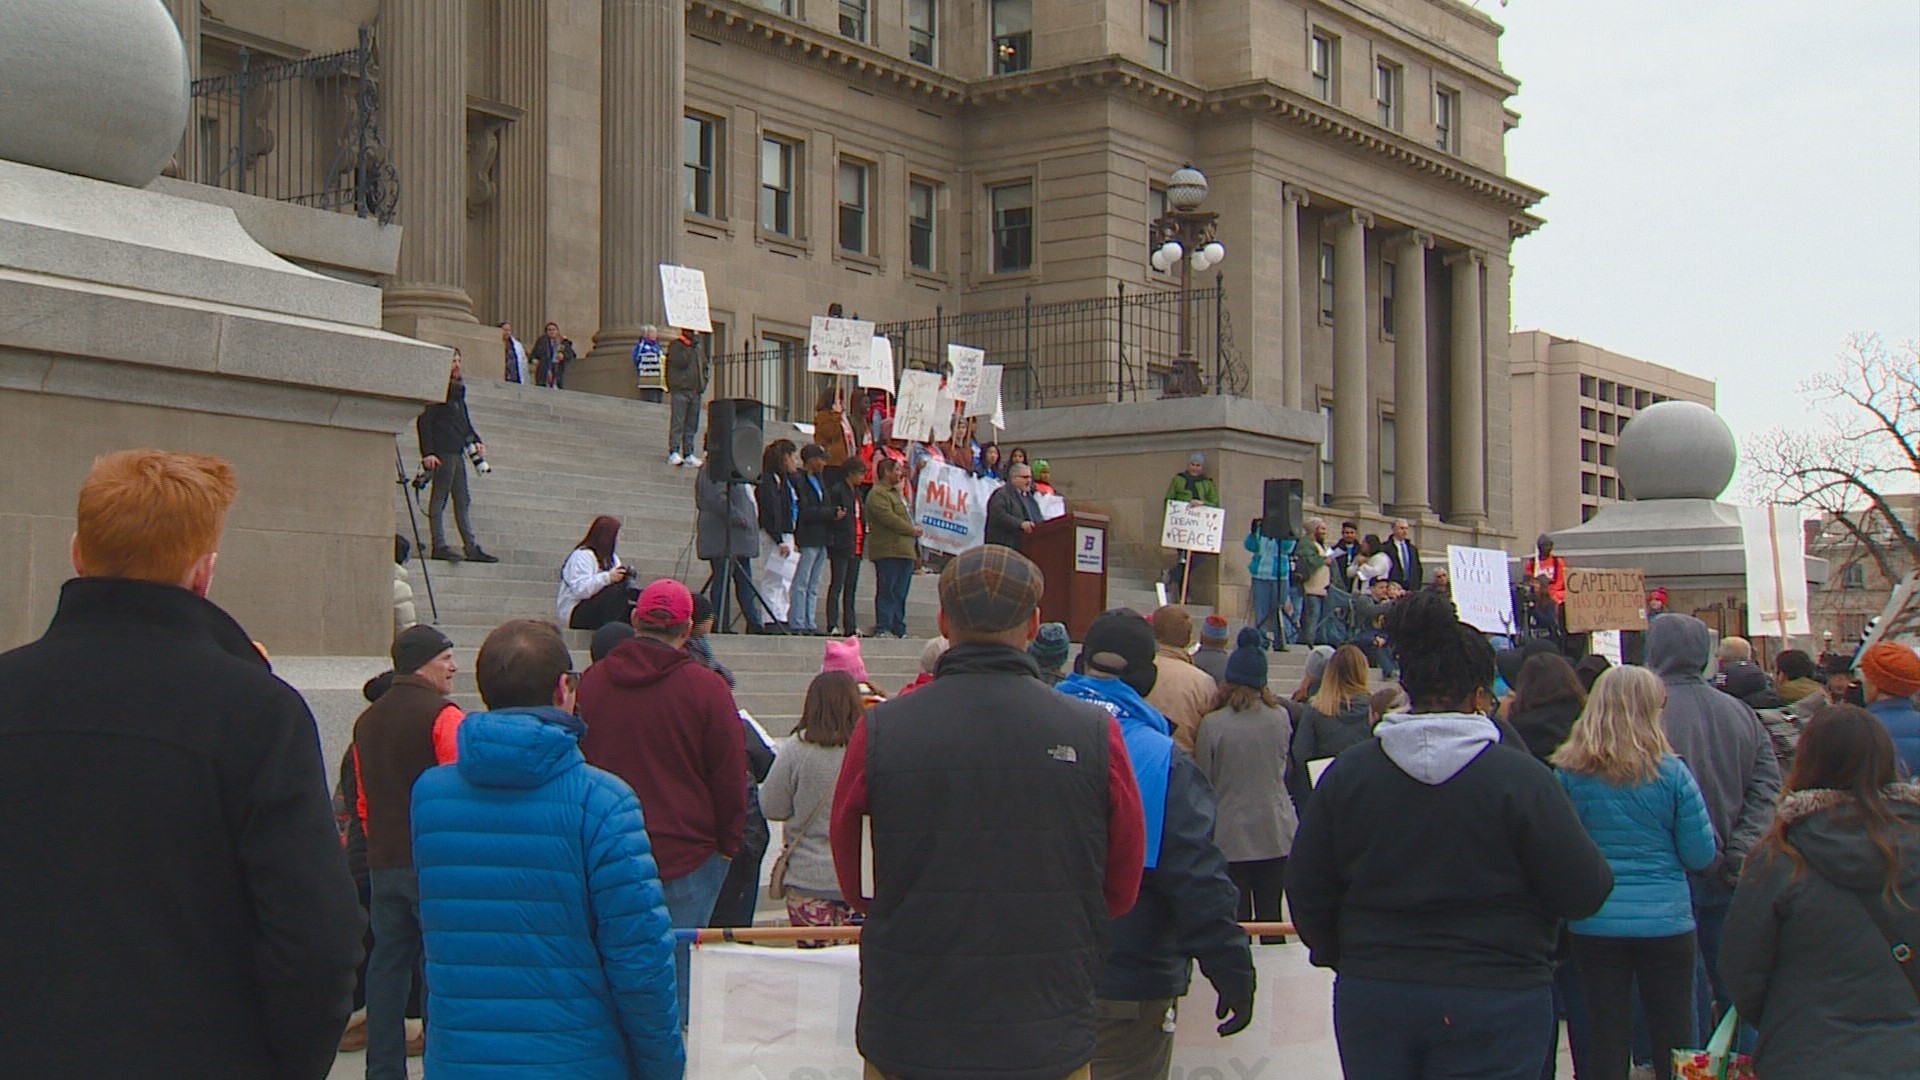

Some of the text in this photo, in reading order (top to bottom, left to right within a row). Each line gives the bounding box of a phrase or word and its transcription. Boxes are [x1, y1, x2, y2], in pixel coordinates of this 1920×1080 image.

[925, 480, 969, 514] MLK
[1168, 504, 1180, 515] I
[1084, 535, 1096, 551] B
[1171, 527, 1215, 547] PEACE
